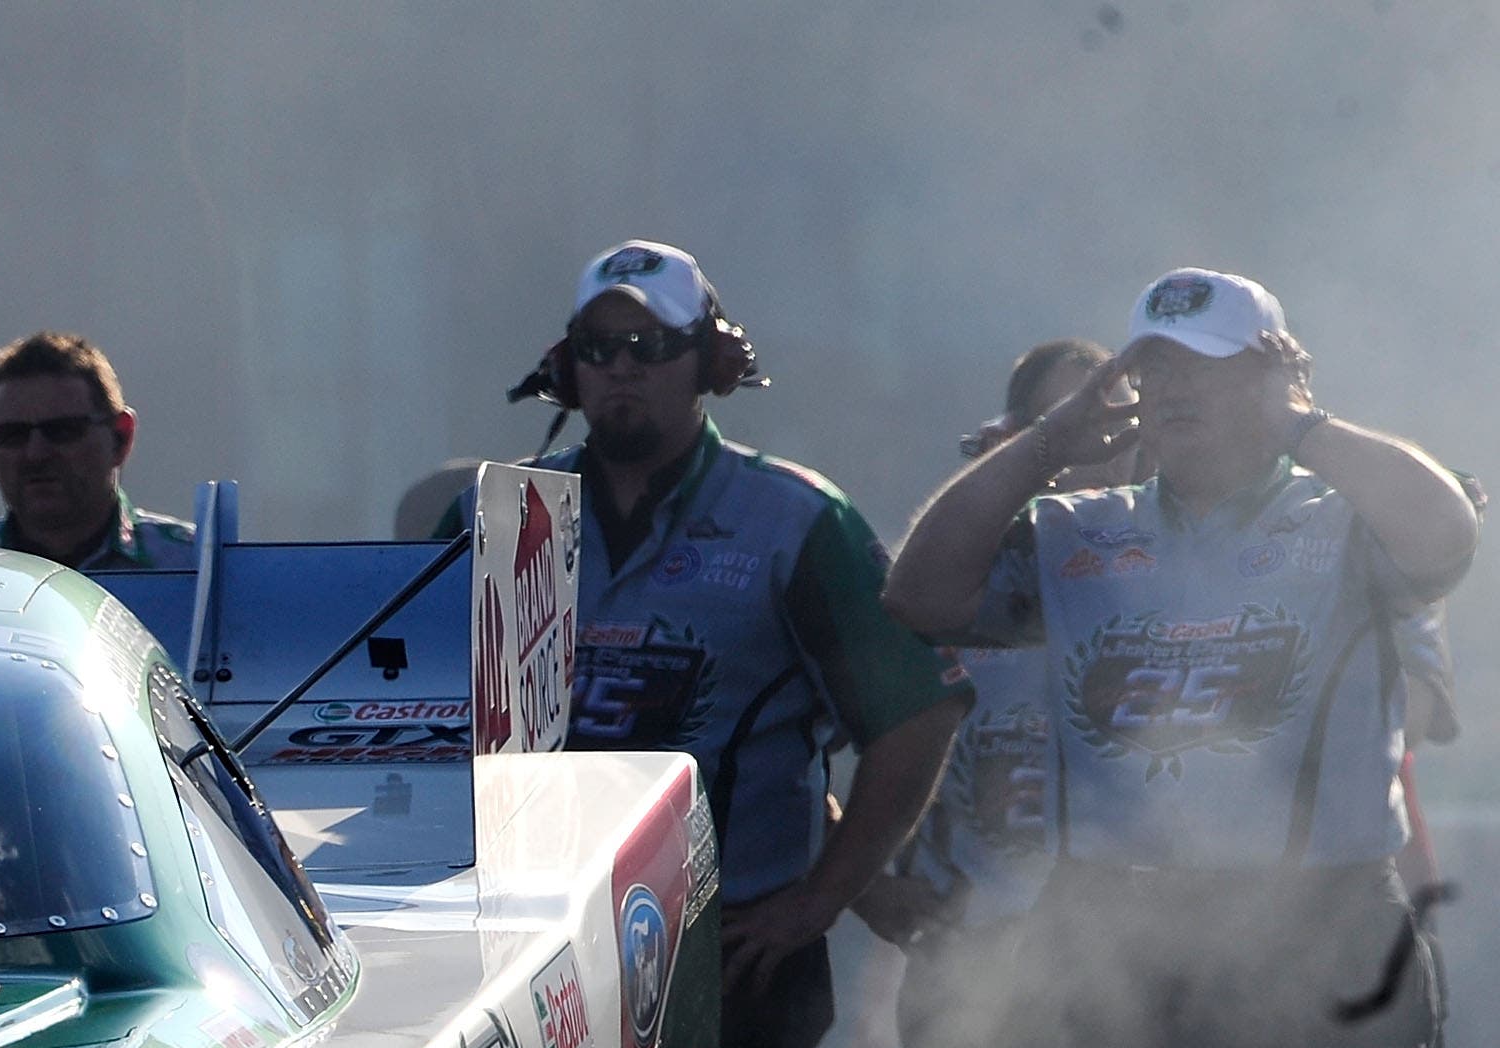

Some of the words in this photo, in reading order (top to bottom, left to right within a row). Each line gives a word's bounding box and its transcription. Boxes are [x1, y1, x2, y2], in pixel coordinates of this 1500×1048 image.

[516, 537, 556, 655] BRAND
[354, 701, 470, 721] Castrol
[519, 629, 561, 752] SOURCE
[1111, 664, 1241, 728] 25
[288, 724, 471, 747] GTX
